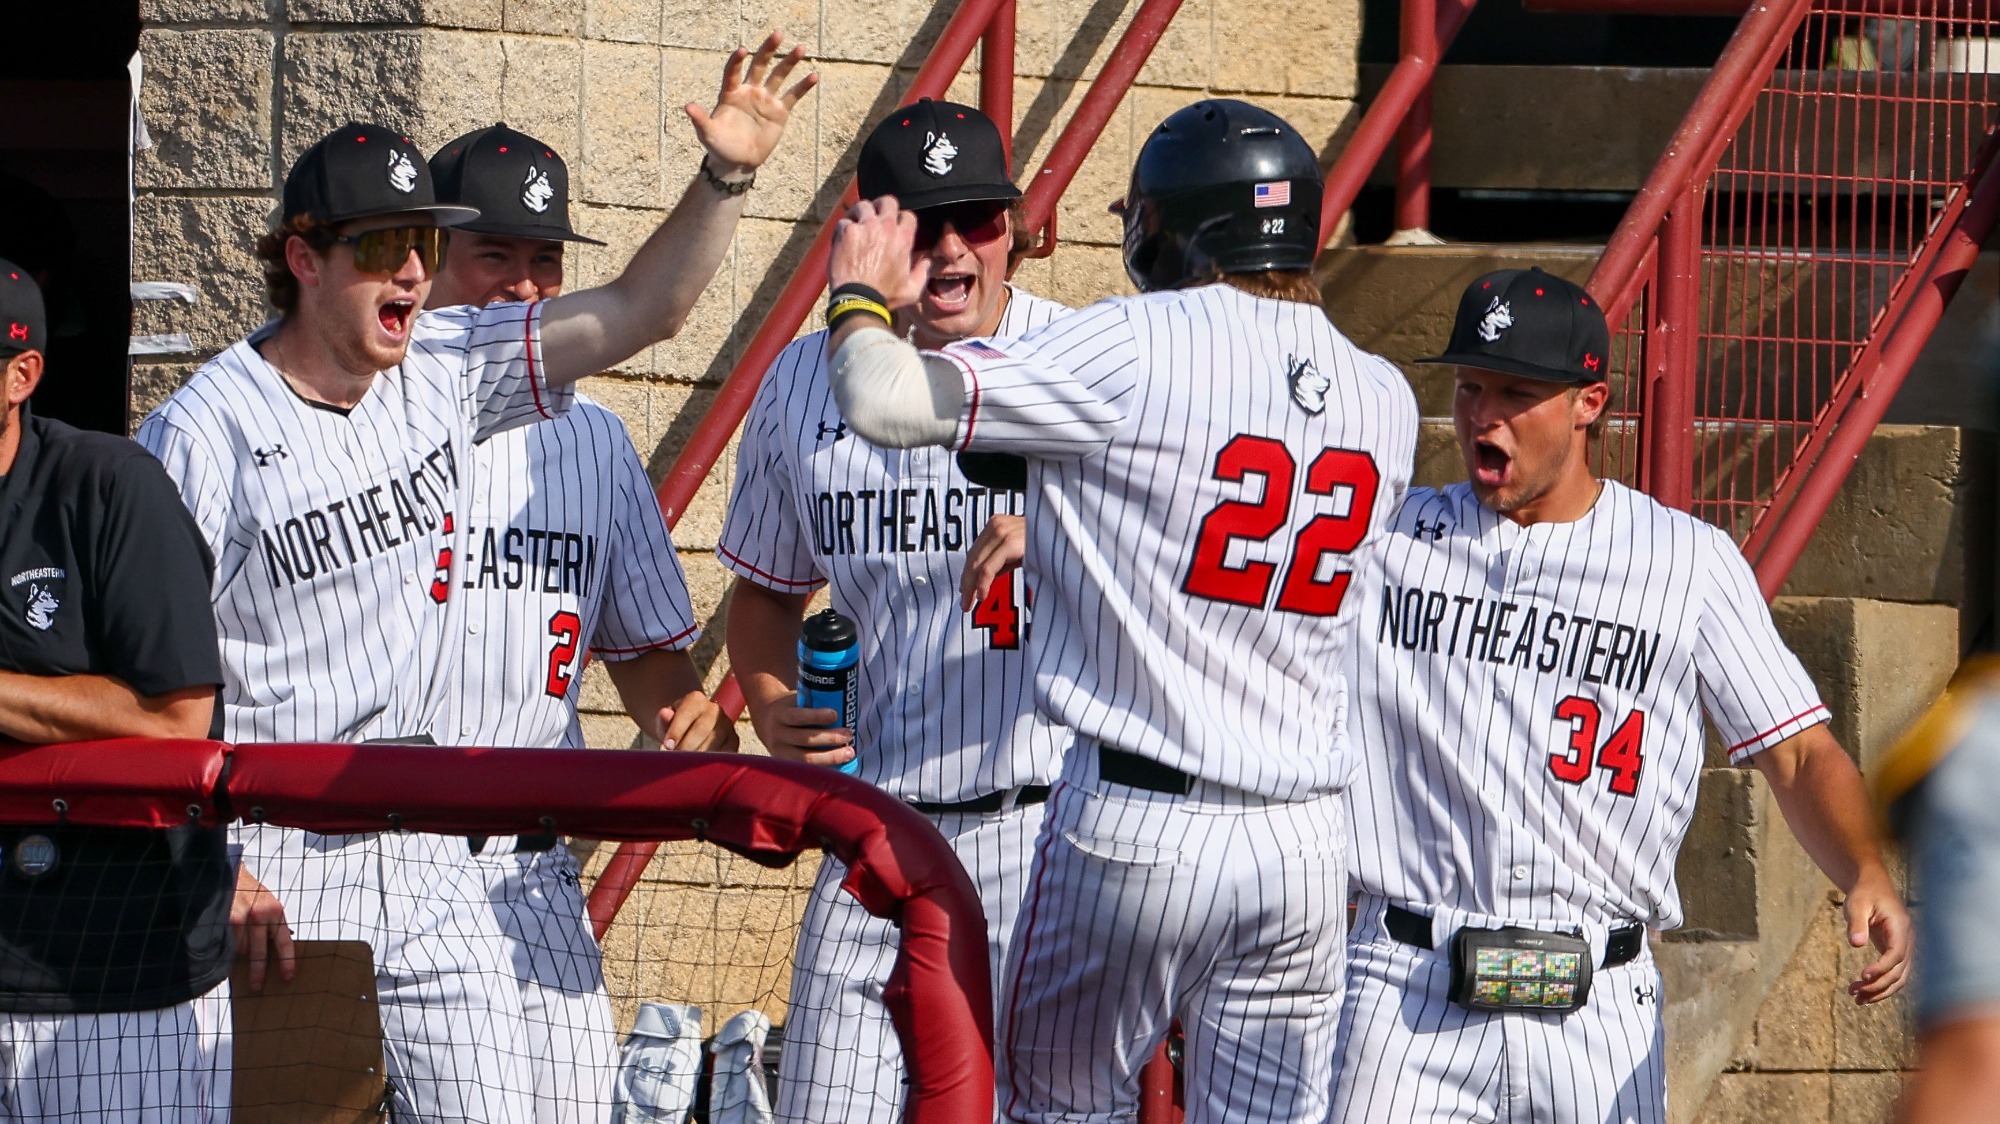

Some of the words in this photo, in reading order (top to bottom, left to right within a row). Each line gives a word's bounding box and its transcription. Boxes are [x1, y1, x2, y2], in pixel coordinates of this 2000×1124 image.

[1271, 218, 1285, 234] 22
[463, 526, 598, 598] EASTERN
[1180, 432, 1380, 617] 22
[11, 567, 65, 587] NORTHEASTERN
[972, 572, 1033, 650] 4
[545, 610, 581, 699] 2
[1379, 585, 1661, 693] NORTHEASTERN
[1548, 695, 1645, 797] 34
